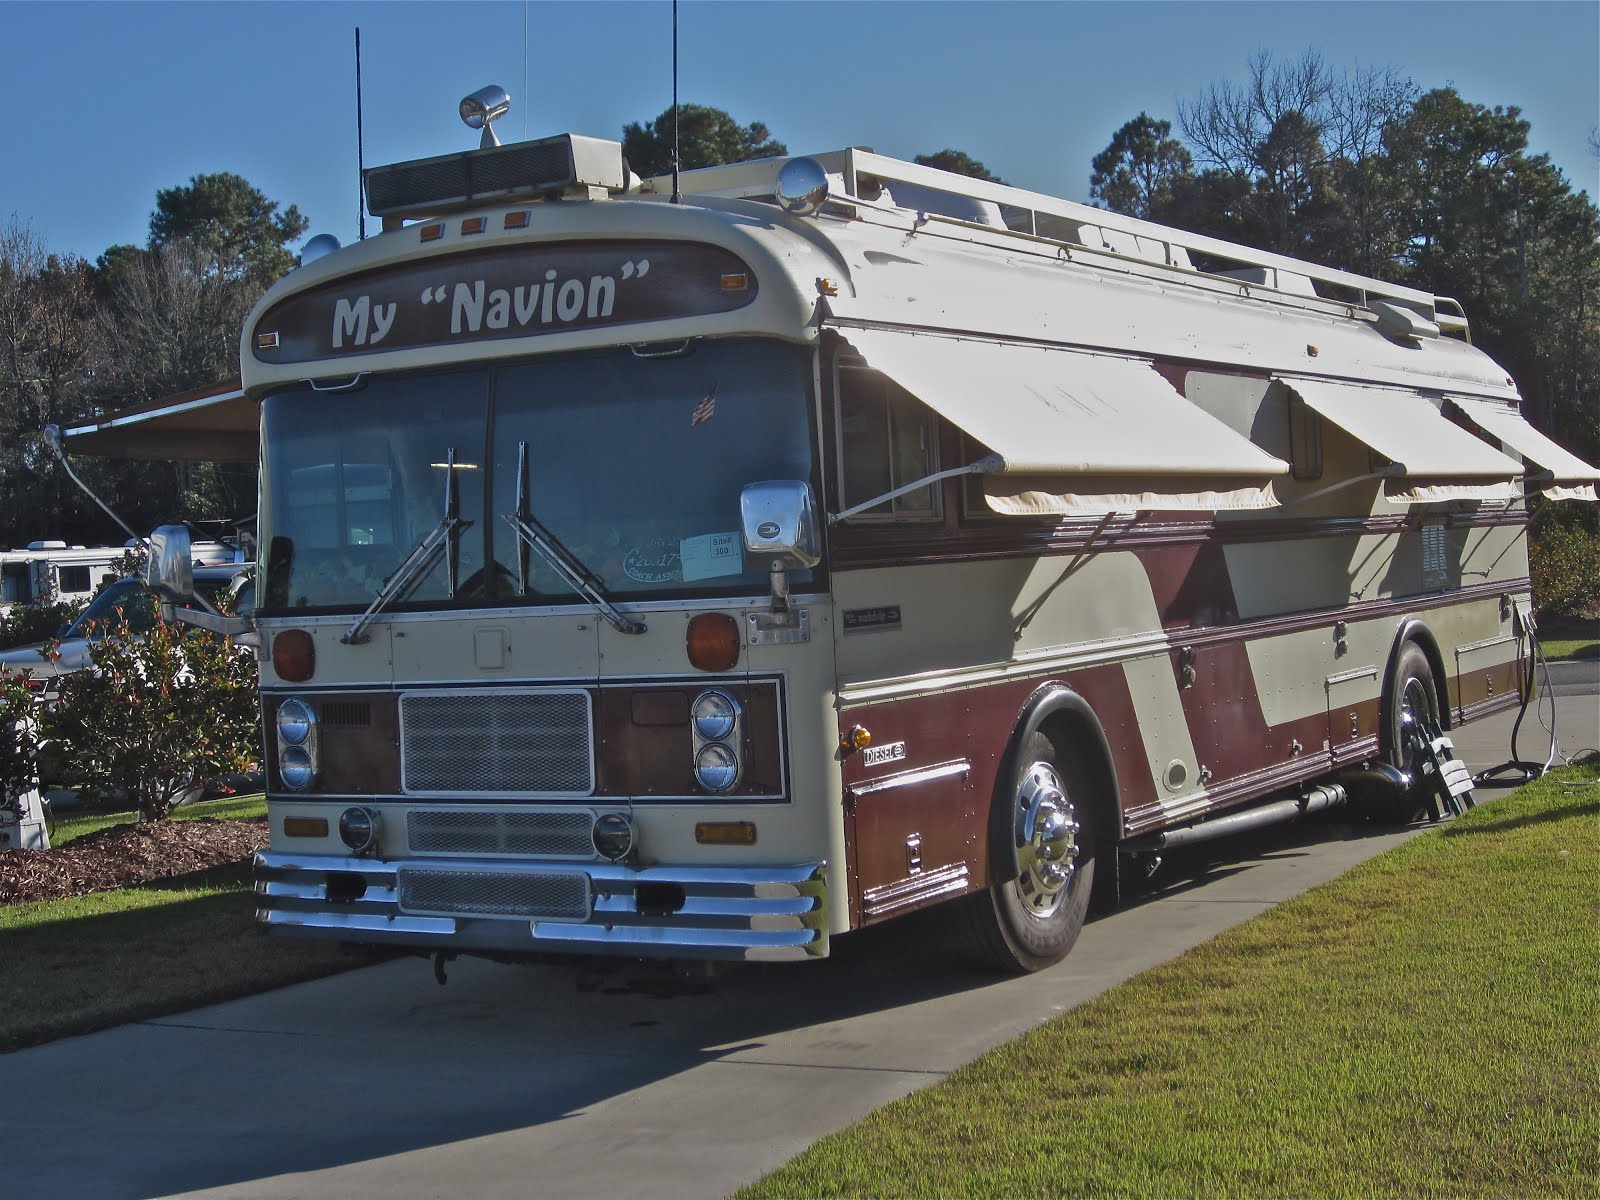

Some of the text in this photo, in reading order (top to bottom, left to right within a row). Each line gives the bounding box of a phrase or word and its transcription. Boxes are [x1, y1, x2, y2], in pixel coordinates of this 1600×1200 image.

[332, 296, 397, 348] My
[715, 547, 729, 555] 300
[867, 746, 893, 763] DIESEL
